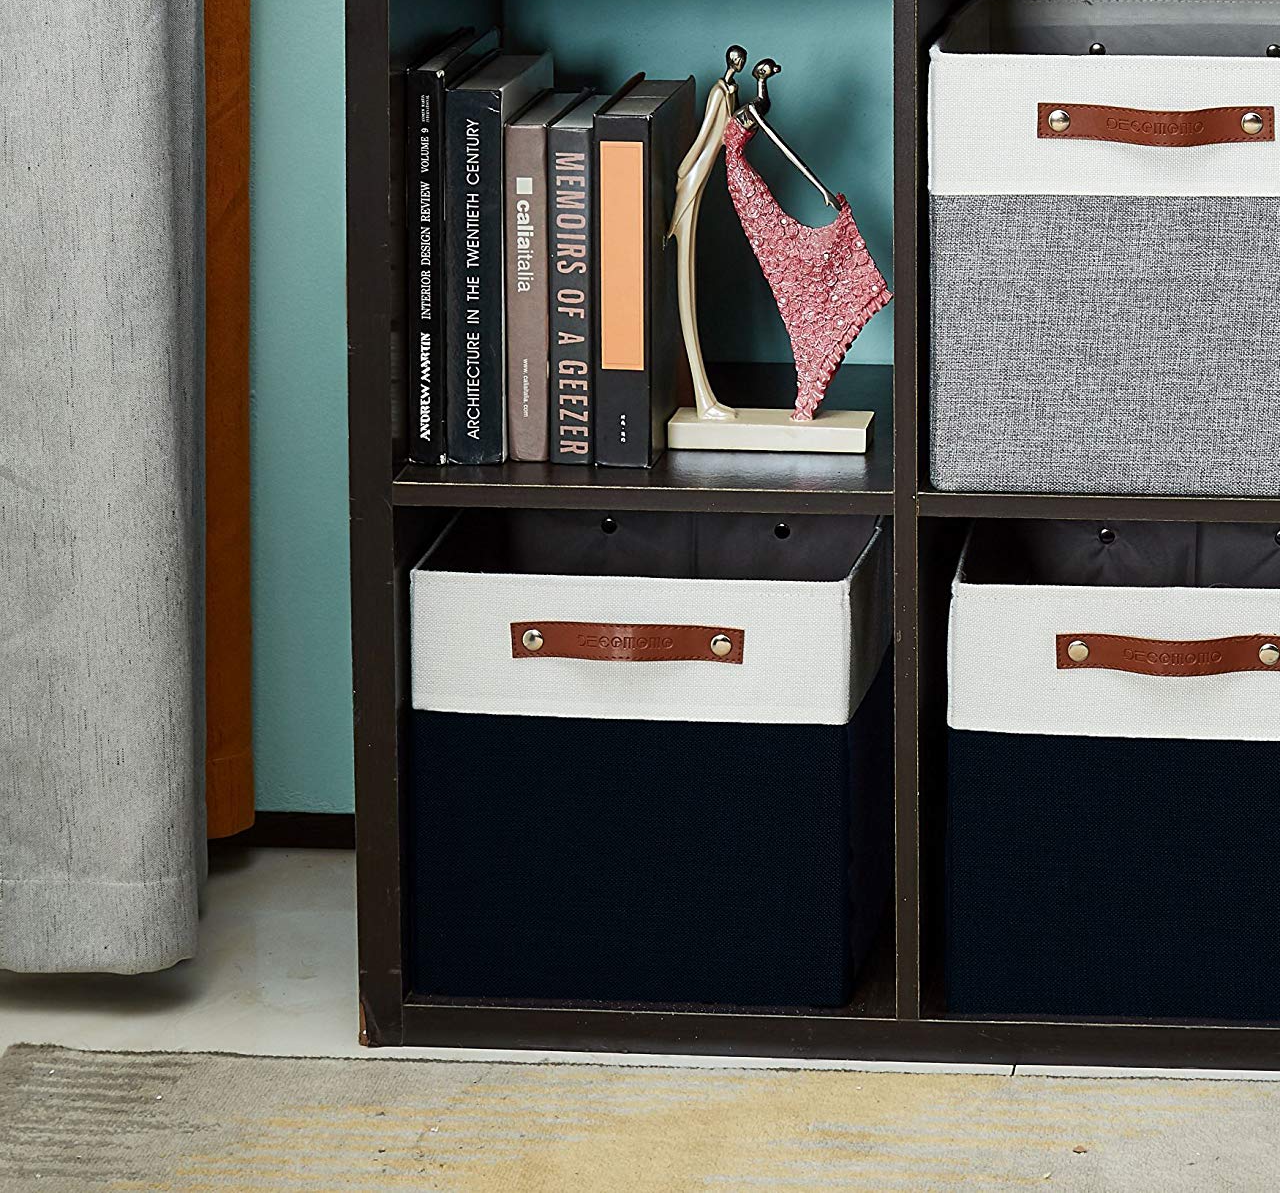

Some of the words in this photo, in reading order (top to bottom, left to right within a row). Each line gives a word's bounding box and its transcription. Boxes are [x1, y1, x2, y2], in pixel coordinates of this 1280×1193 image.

[420, 136, 430, 173] VOLUME
[466, 118, 480, 186] CENTURY
[420, 180, 431, 223] REVIEW
[554, 152, 588, 274] MEMOIRS
[420, 226, 431, 266] DESIGN
[466, 193, 480, 269] TWENTIETH
[516, 199, 535, 293] caliaitalia
[420, 270, 432, 320] INTERIOR
[466, 276, 480, 302] THE
[556, 288, 585, 319] OF
[466, 309, 480, 324] IN
[557, 331, 585, 345] A
[420, 331, 431, 383] MARTIN
[466, 332, 481, 440] ARCHITECTURE
[558, 359, 589, 455] GEEZER
[419, 383, 431, 442] ANDREW
